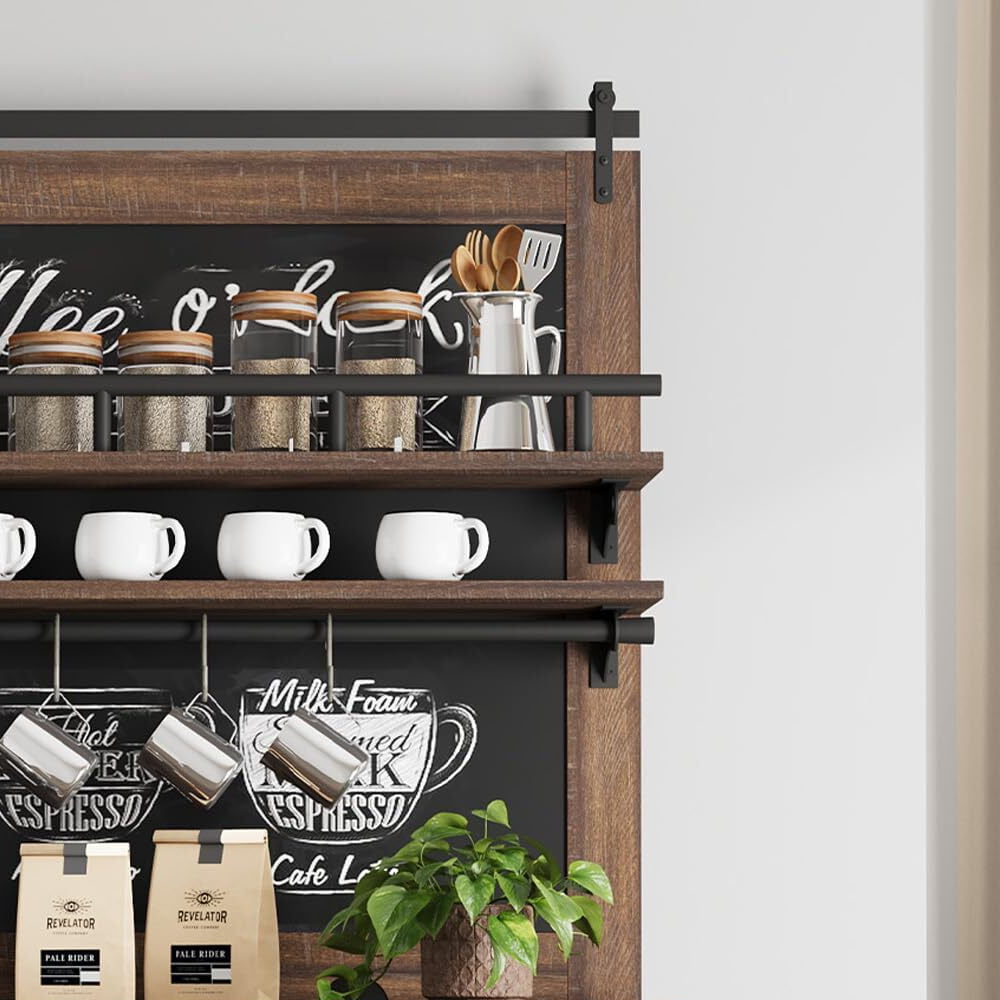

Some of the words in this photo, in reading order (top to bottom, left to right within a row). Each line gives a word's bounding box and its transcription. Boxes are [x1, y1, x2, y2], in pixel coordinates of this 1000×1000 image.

[259, 678, 334, 713] Milk
[345, 679, 418, 714] Foam
[271, 853, 329, 886] Cafe
[47, 917, 96, 930] REVELATOR
[177, 910, 228, 924] REVELATOR
[68, 954, 95, 962] RIDER
[175, 950, 196, 958] PALE
[199, 950, 226, 958] RIDER
